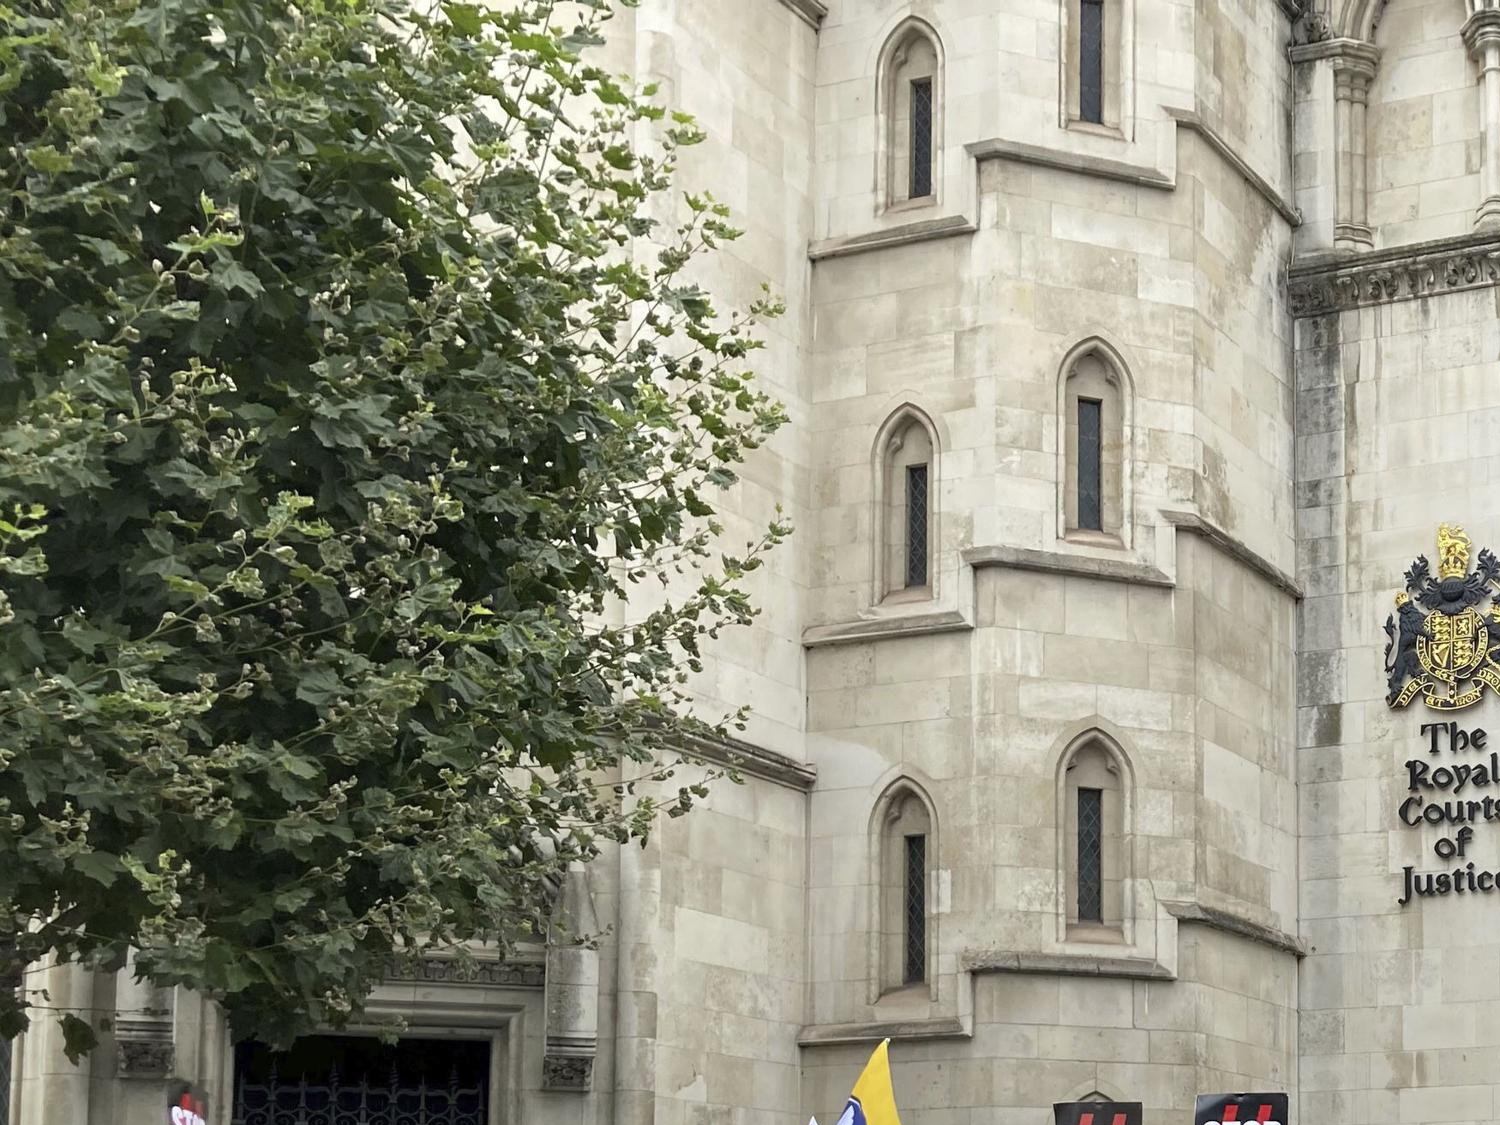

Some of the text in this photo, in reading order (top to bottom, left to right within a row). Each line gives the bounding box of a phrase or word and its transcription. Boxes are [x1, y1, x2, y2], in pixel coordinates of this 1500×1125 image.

[1420, 721, 1487, 753] The
[1405, 752, 1500, 794] Royal
[1434, 826, 1473, 859] of
